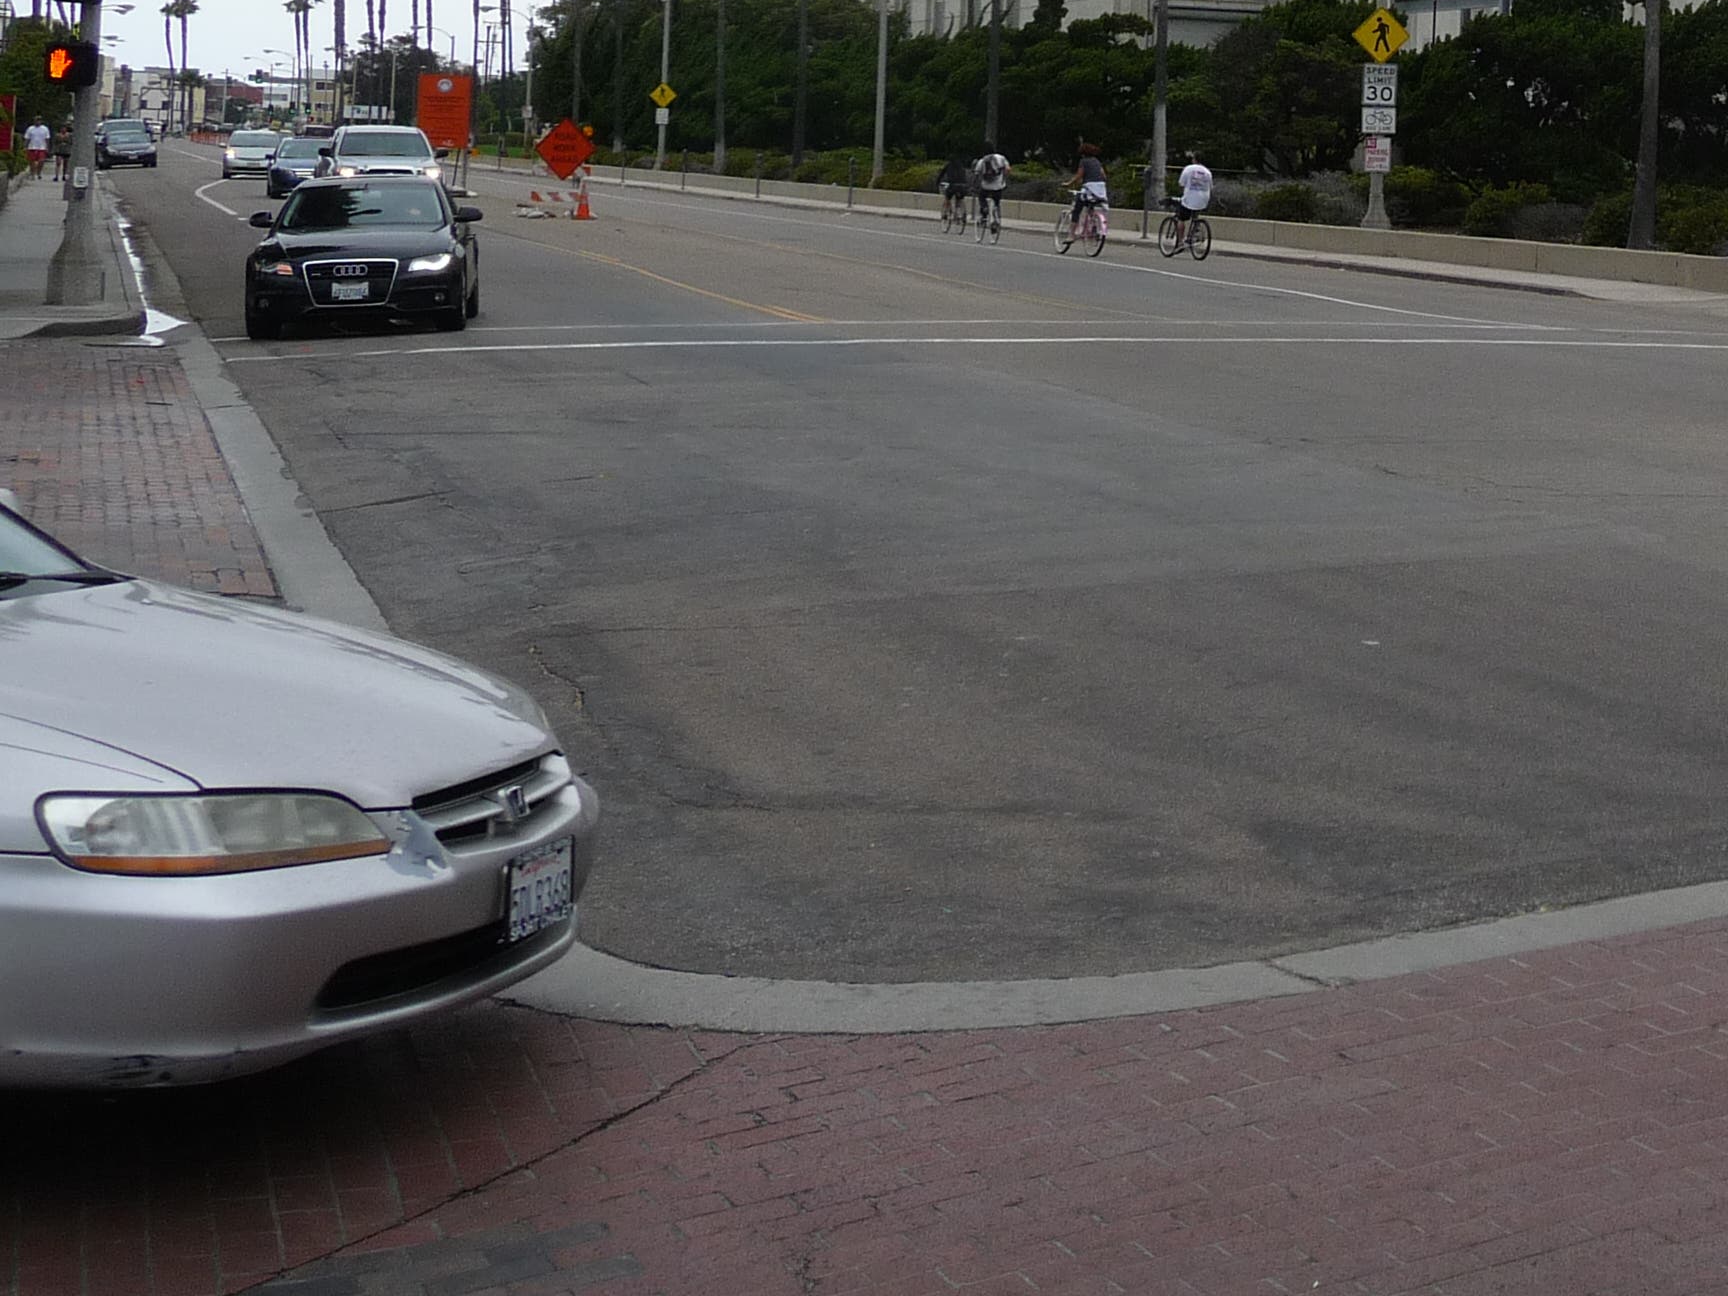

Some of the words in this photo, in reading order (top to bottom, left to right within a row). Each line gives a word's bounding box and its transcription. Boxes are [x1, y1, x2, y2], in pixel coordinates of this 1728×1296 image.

[1366, 66, 1396, 75] SPEED
[1367, 76, 1392, 84] LIMIT
[1366, 85, 1393, 102] 30
[553, 143, 576, 152] WORK
[551, 154, 579, 163] AHEAD
